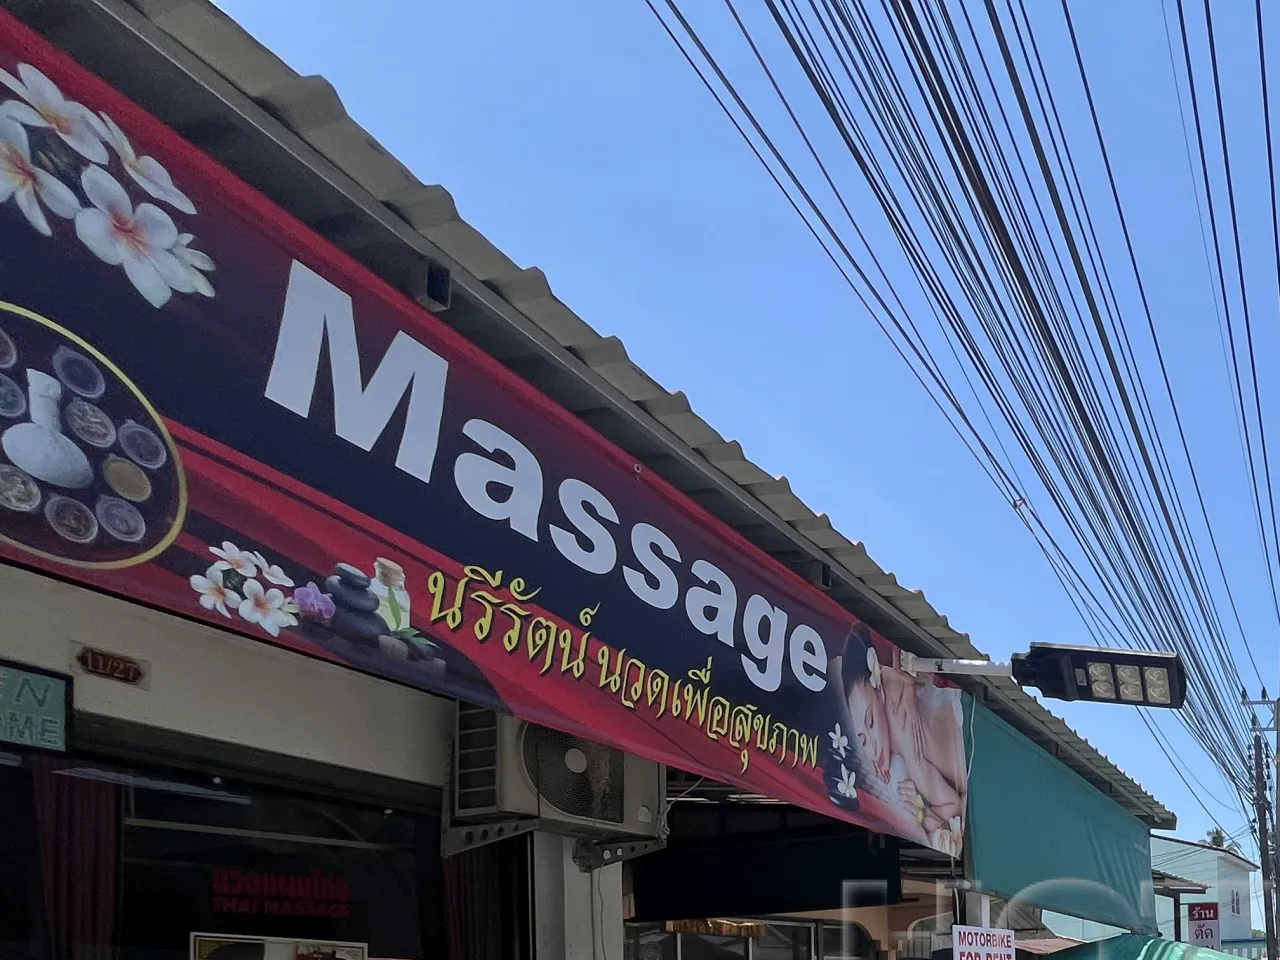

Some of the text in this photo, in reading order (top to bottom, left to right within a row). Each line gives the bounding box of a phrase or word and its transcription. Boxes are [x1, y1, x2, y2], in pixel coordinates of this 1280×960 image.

[264, 258, 829, 693] Massage
[84, 653, 137, 682] 11/27
[598, 655, 821, 774] นวดเพื่อสุขภาพ
[1192, 906, 1214, 919] ร้าน
[958, 931, 1012, 949] MOTORBIKE
[1194, 923, 1214, 940] ตัด
